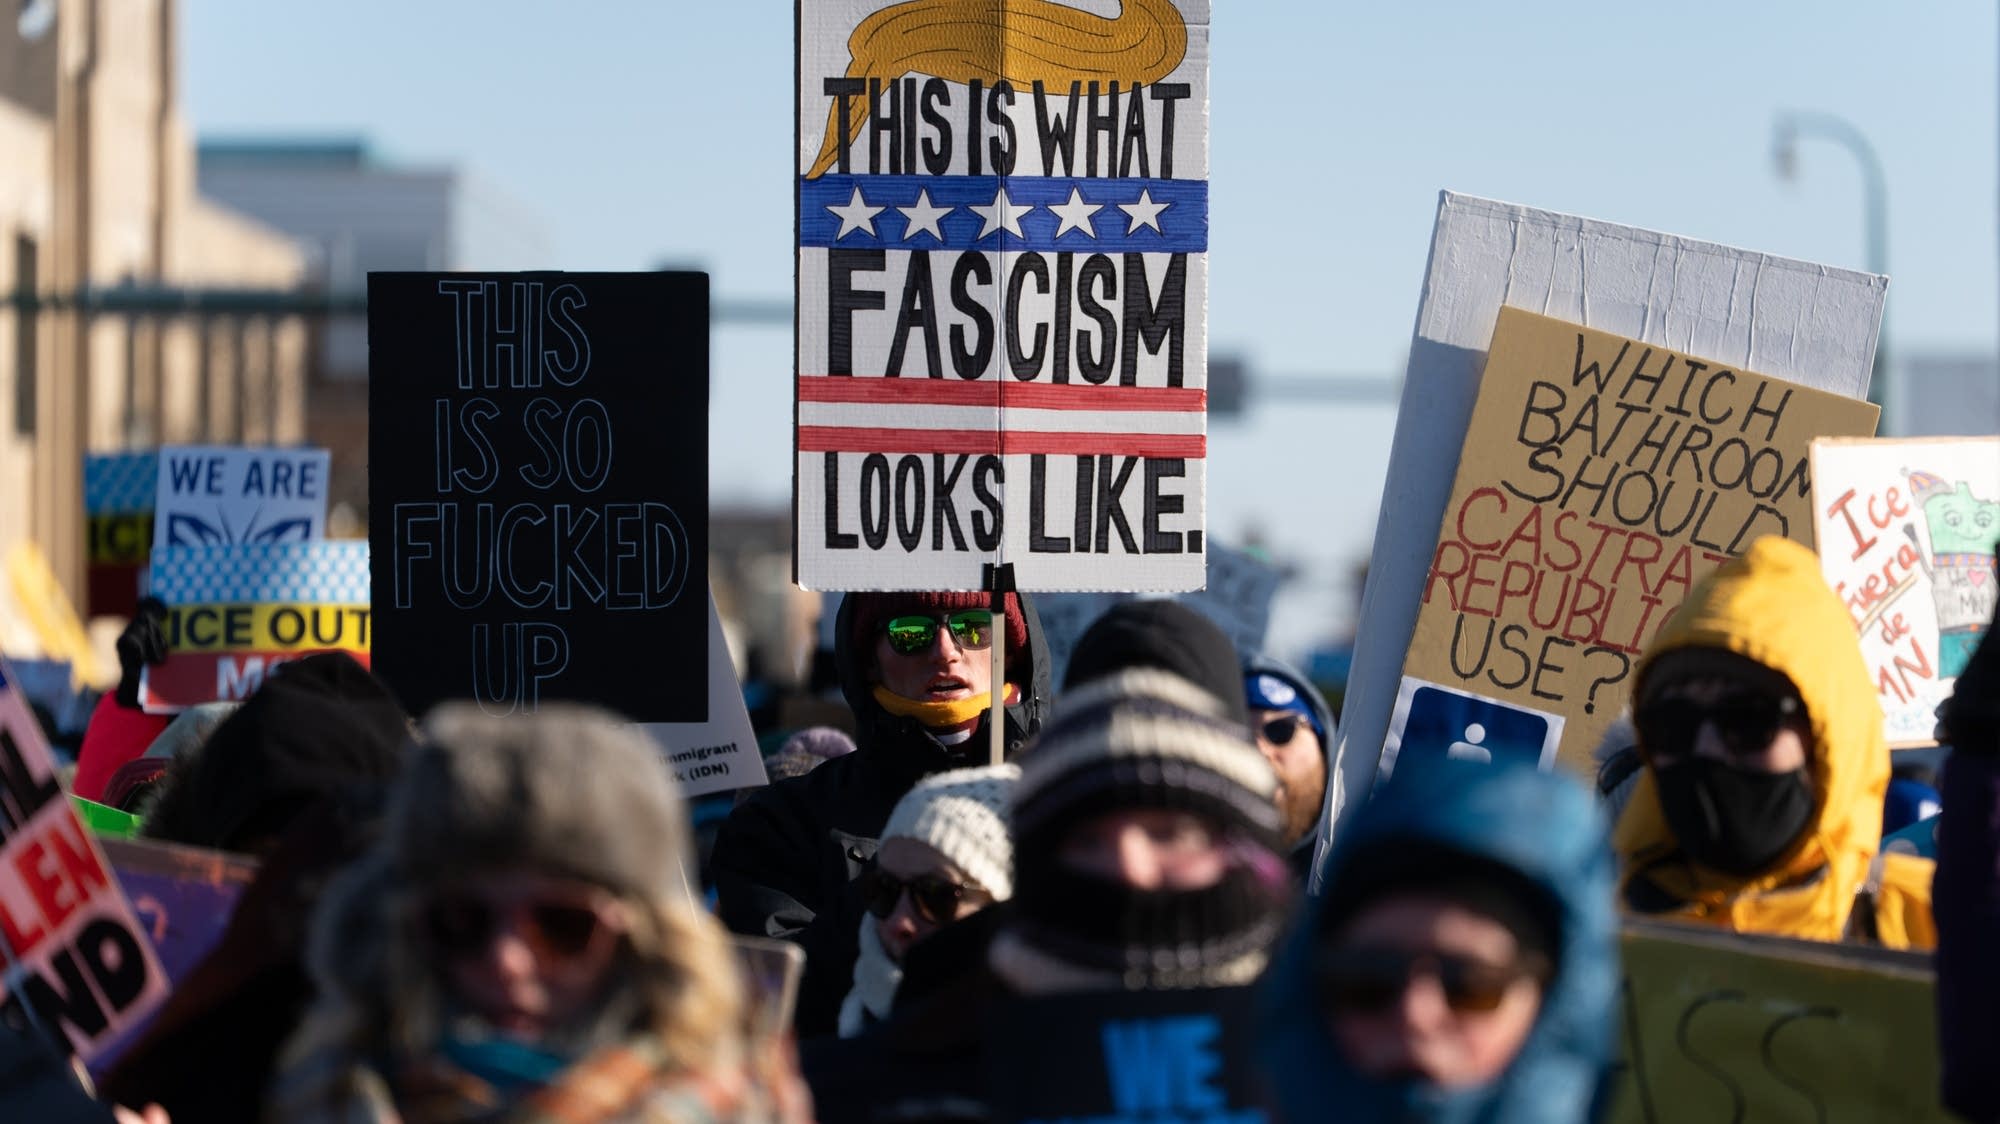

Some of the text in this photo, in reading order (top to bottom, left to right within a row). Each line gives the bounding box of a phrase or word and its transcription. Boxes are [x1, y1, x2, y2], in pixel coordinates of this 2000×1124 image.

[824, 77, 1191, 180] THIS IS WHAT
[438, 280, 591, 389] THIS
[828, 248, 1188, 387] FASCISM
[1572, 333, 1793, 441] WHICH
[168, 456, 319, 500] WE ARE
[436, 398, 612, 493] IS SO
[825, 451, 1202, 554] LOOKS LIKE.
[1501, 444, 1789, 557] SHOULD
[394, 502, 689, 611] FUCKED
[1423, 540, 1681, 655] REPUBLI
[170, 607, 254, 649] ICE
[473, 622, 569, 718] UP
[1450, 613, 1630, 715] USE?
[689, 762, 729, 781] (IDN)
